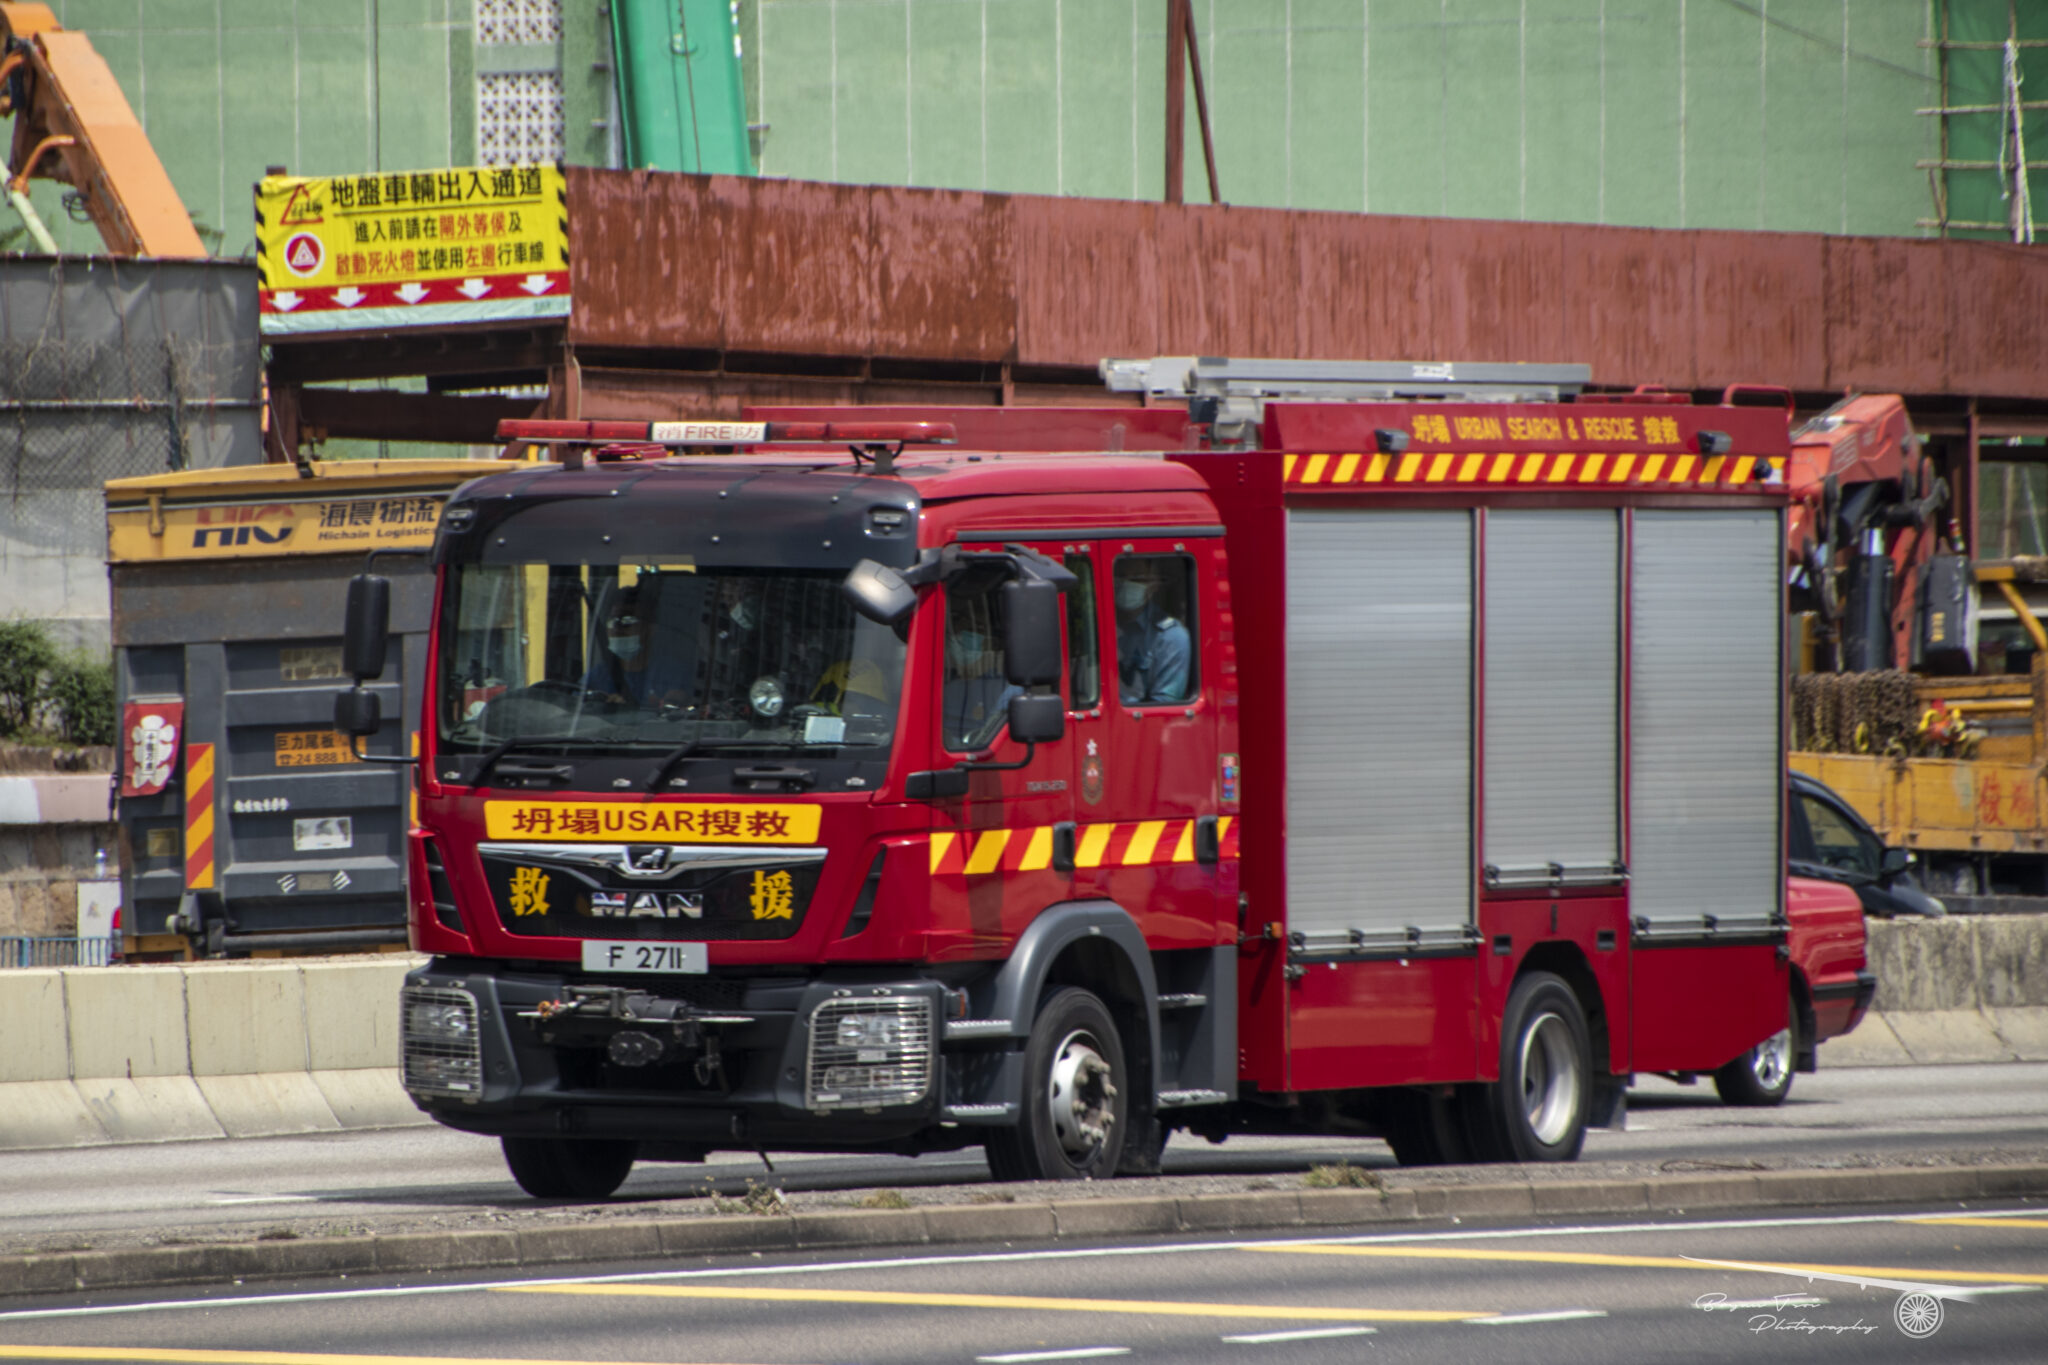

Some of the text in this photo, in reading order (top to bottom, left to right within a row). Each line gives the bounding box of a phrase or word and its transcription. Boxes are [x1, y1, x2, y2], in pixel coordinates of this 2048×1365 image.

[330, 167, 543, 207] 地盤車輛出入通道
[1453, 416, 1504, 440] URBAN
[1506, 416, 1562, 441] SEARCH
[1566, 416, 1579, 441] &
[1582, 416, 1639, 441] RESCUE
[319, 498, 437, 528] 海晨物流
[318, 530, 370, 541] Hichain
[509, 867, 550, 917] 救
[591, 892, 703, 918] MAN
[750, 870, 793, 920] 援
[608, 946, 683, 969] F 2711
